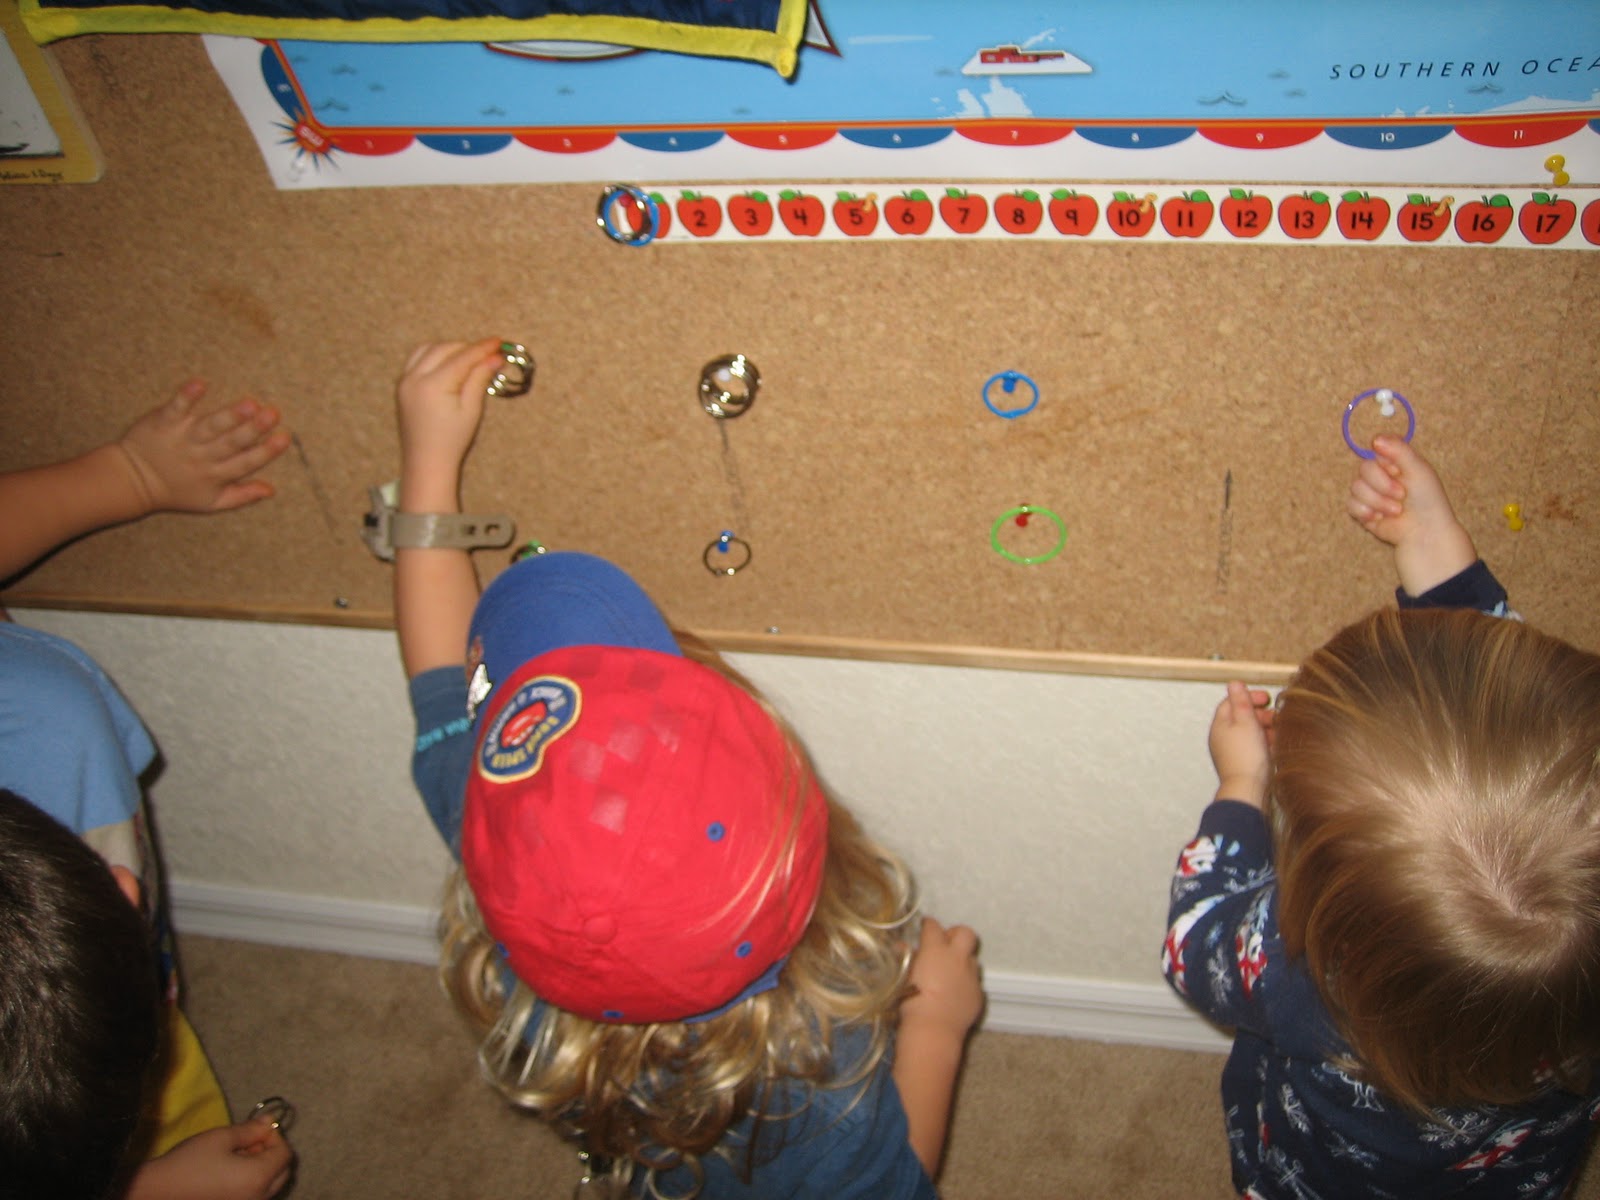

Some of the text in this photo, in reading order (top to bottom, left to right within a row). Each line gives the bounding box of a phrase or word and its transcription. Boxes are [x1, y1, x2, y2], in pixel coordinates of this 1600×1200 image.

[1329, 62, 1500, 80] SOUTHERN
[1380, 132, 1395, 143] 10
[1513, 129, 1524, 140] 11
[694, 210, 707, 228] 2
[745, 208, 759, 227] 3
[793, 210, 808, 225] 4
[849, 208, 863, 225] 5
[901, 209, 915, 225] 6
[958, 207, 971, 225] 7
[1012, 208, 1025, 225] 8
[1065, 209, 1079, 226] 9
[1118, 209, 1141, 226] 10
[1177, 210, 1194, 228] 11
[1237, 210, 1258, 228] 12
[1294, 210, 1315, 229] 13
[1351, 212, 1374, 229] 14
[1411, 212, 1434, 230] 15
[1472, 213, 1496, 232] 16
[1536, 214, 1561, 233] 17
